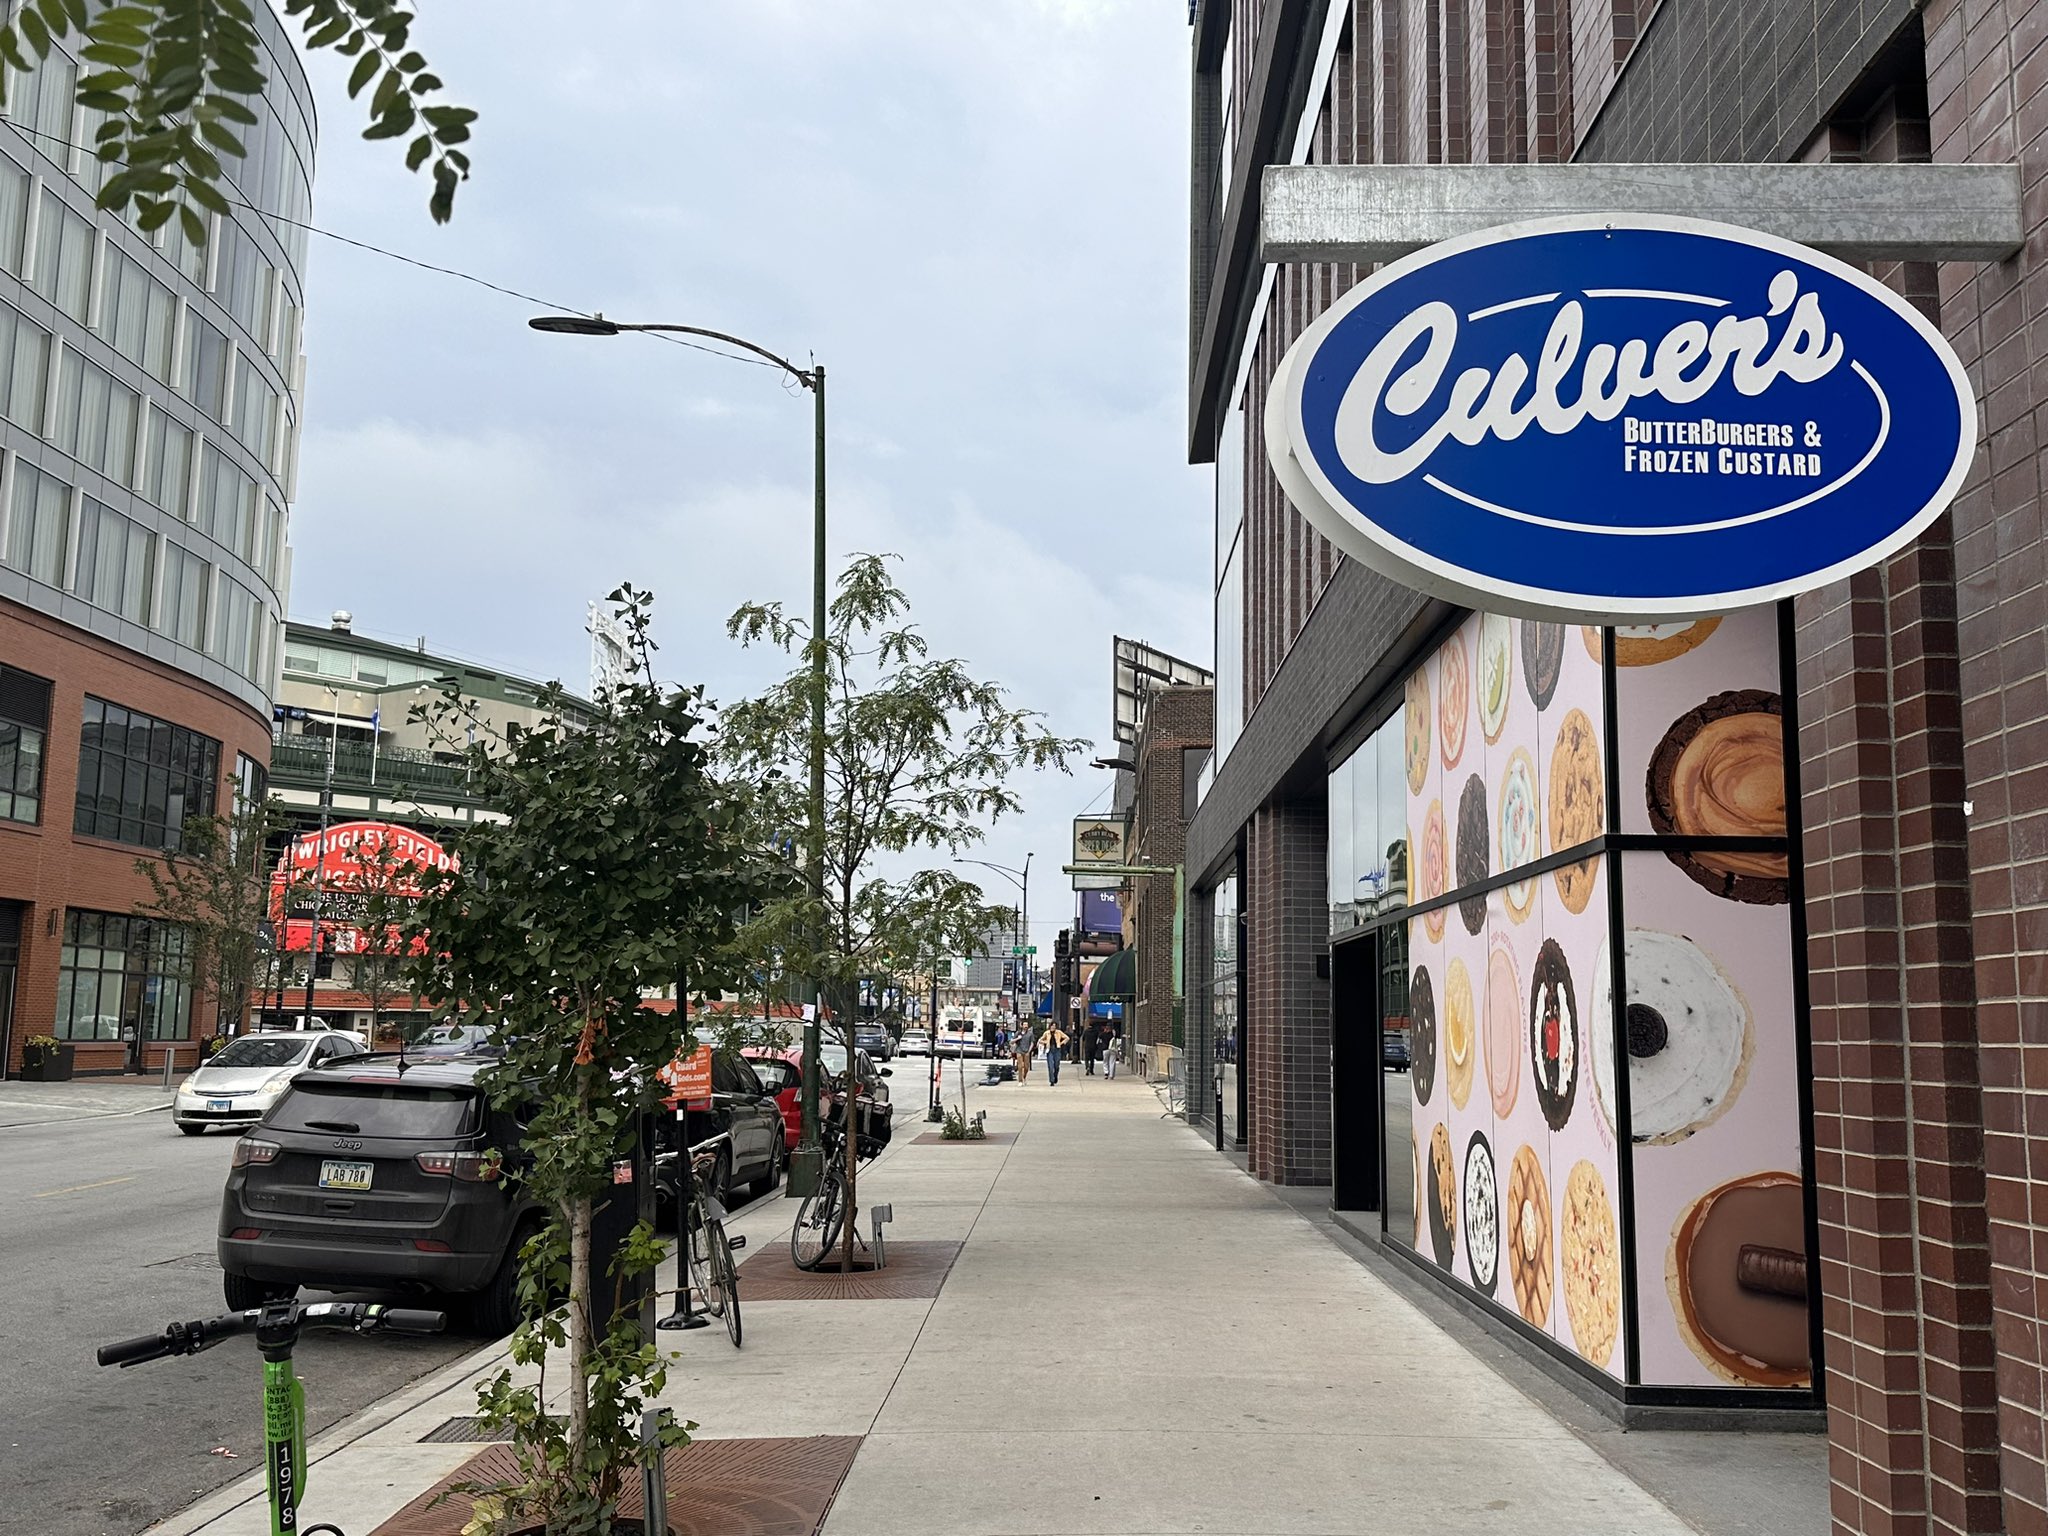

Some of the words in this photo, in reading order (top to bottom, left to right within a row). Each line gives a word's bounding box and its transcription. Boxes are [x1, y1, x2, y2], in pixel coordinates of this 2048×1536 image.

[1335, 269, 1844, 484] Culver's
[1624, 417, 1794, 446] BUTTERBURGERS
[1803, 420, 1822, 447] &
[1624, 445, 1709, 473] FROZEN
[1718, 448, 1821, 476] CUSTARD
[299, 829, 390, 860] WRIGLEY
[397, 834, 451, 872] FIELD
[1100, 892, 1115, 902] the
[675, 1061, 697, 1071] Guard
[1580, 1027, 1592, 1089] TASTE
[1588, 1089, 1612, 1153] WEEKLY
[333, 1138, 362, 1151] Jeep
[327, 1169, 346, 1182] LAB
[348, 1169, 366, 1183] 780
[280, 1446, 294, 1525] 1978
